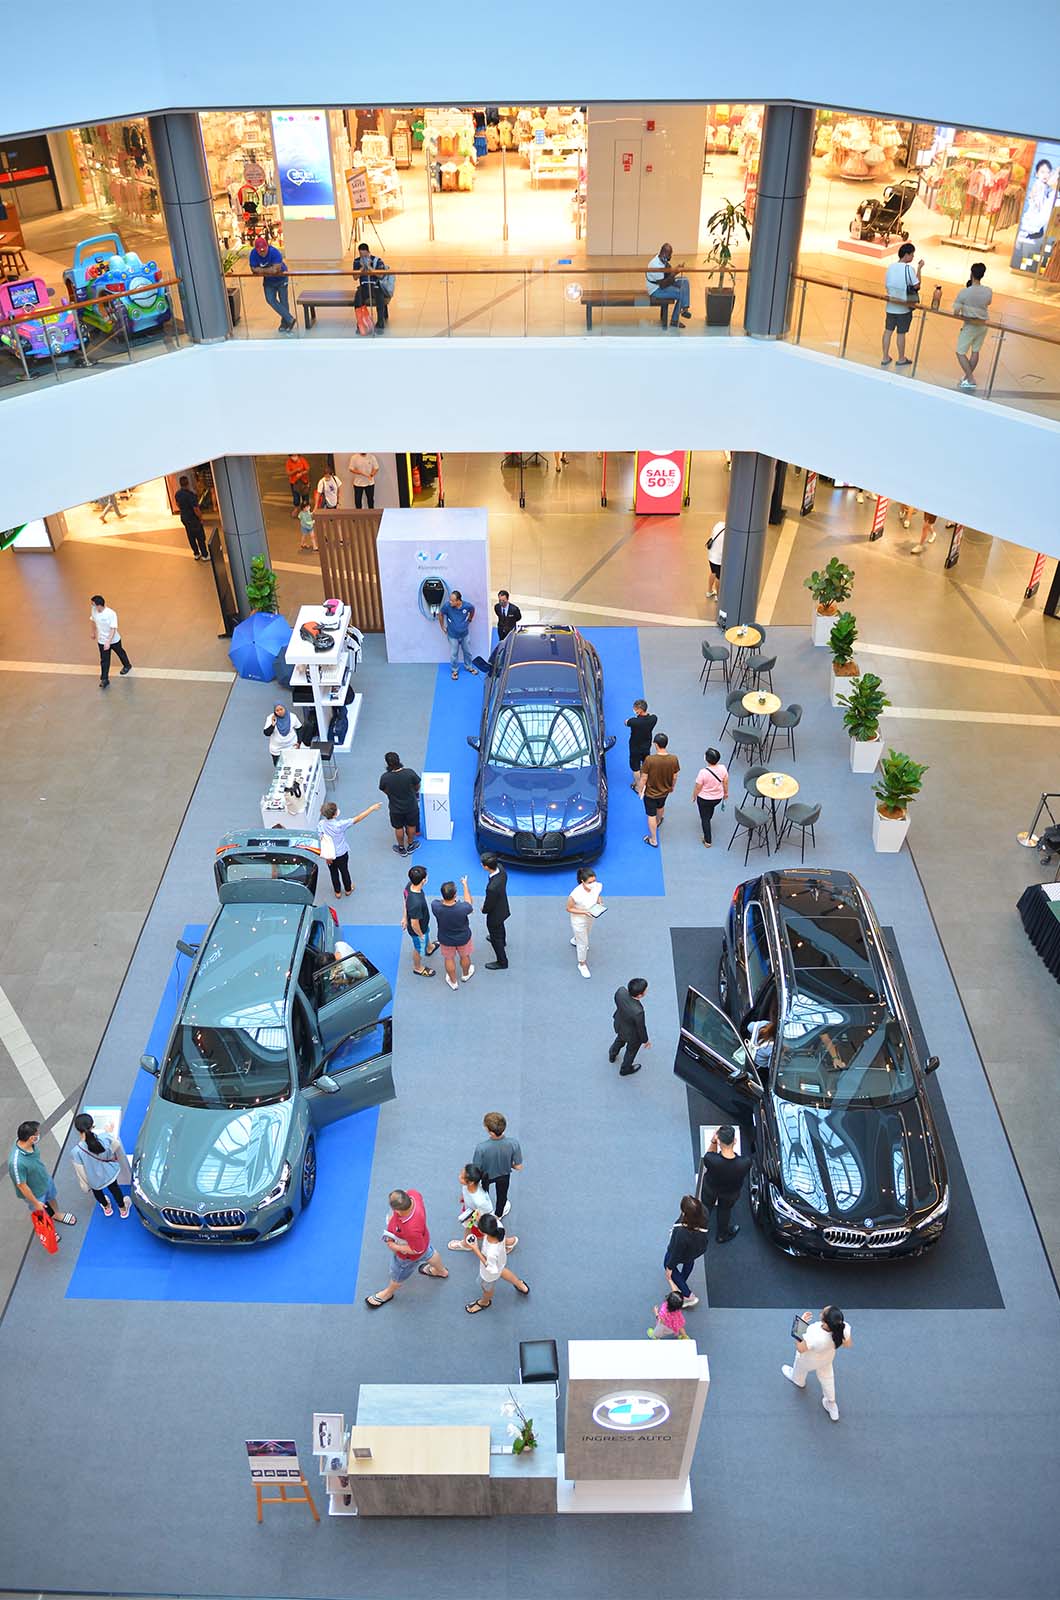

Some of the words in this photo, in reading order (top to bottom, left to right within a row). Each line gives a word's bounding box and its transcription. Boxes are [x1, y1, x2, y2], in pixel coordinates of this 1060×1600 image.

[646, 469, 676, 477] SALE
[432, 799, 448, 812] iX
[581, 1434, 635, 1442] INGRESS
[638, 1434, 672, 1442] AUTO
